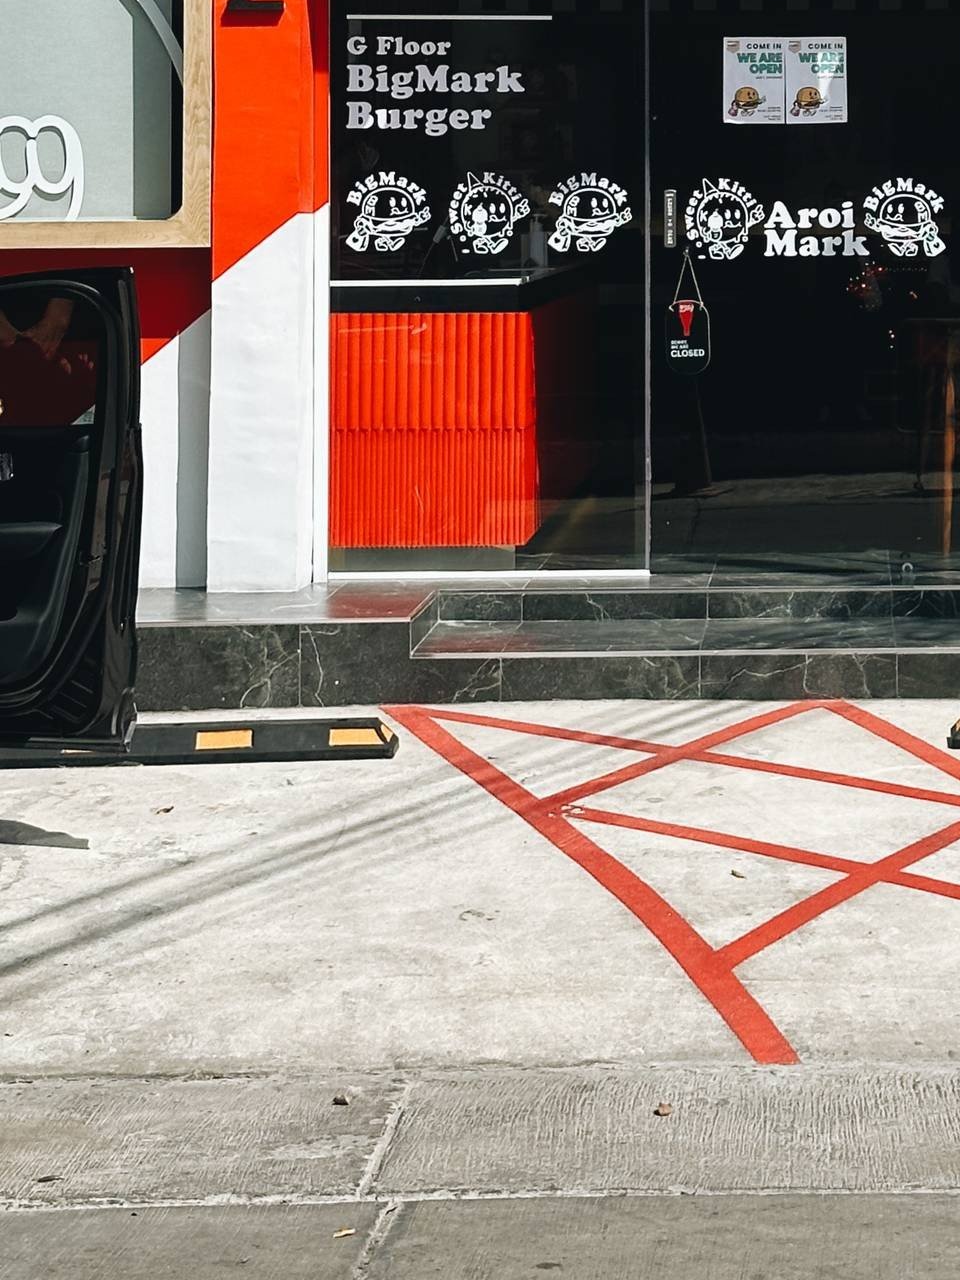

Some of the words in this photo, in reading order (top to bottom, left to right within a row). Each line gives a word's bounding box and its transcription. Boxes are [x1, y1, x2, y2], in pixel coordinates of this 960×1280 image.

[346, 35, 368, 55] G
[376, 36, 451, 56] Floor
[737, 52, 757, 63] WE
[758, 52, 783, 63] ARE
[798, 52, 818, 63] WE
[346, 64, 526, 100] BigMark
[749, 63, 783, 74] OPEN
[811, 63, 844, 74] OPEN
[345, 101, 492, 137] Burger
[346, 171, 429, 207] BigMark
[448, 183, 469, 235] Sweet
[482, 172, 521, 202] Kitti
[548, 172, 629, 207] BigMark
[862, 177, 946, 214] BigMark
[684, 189, 704, 241] Sweet
[718, 178, 755, 207] Kitti
[763, 200, 856, 229] Aroi
[763, 228, 870, 257] Mark
[670, 349, 705, 358] CLOSED
